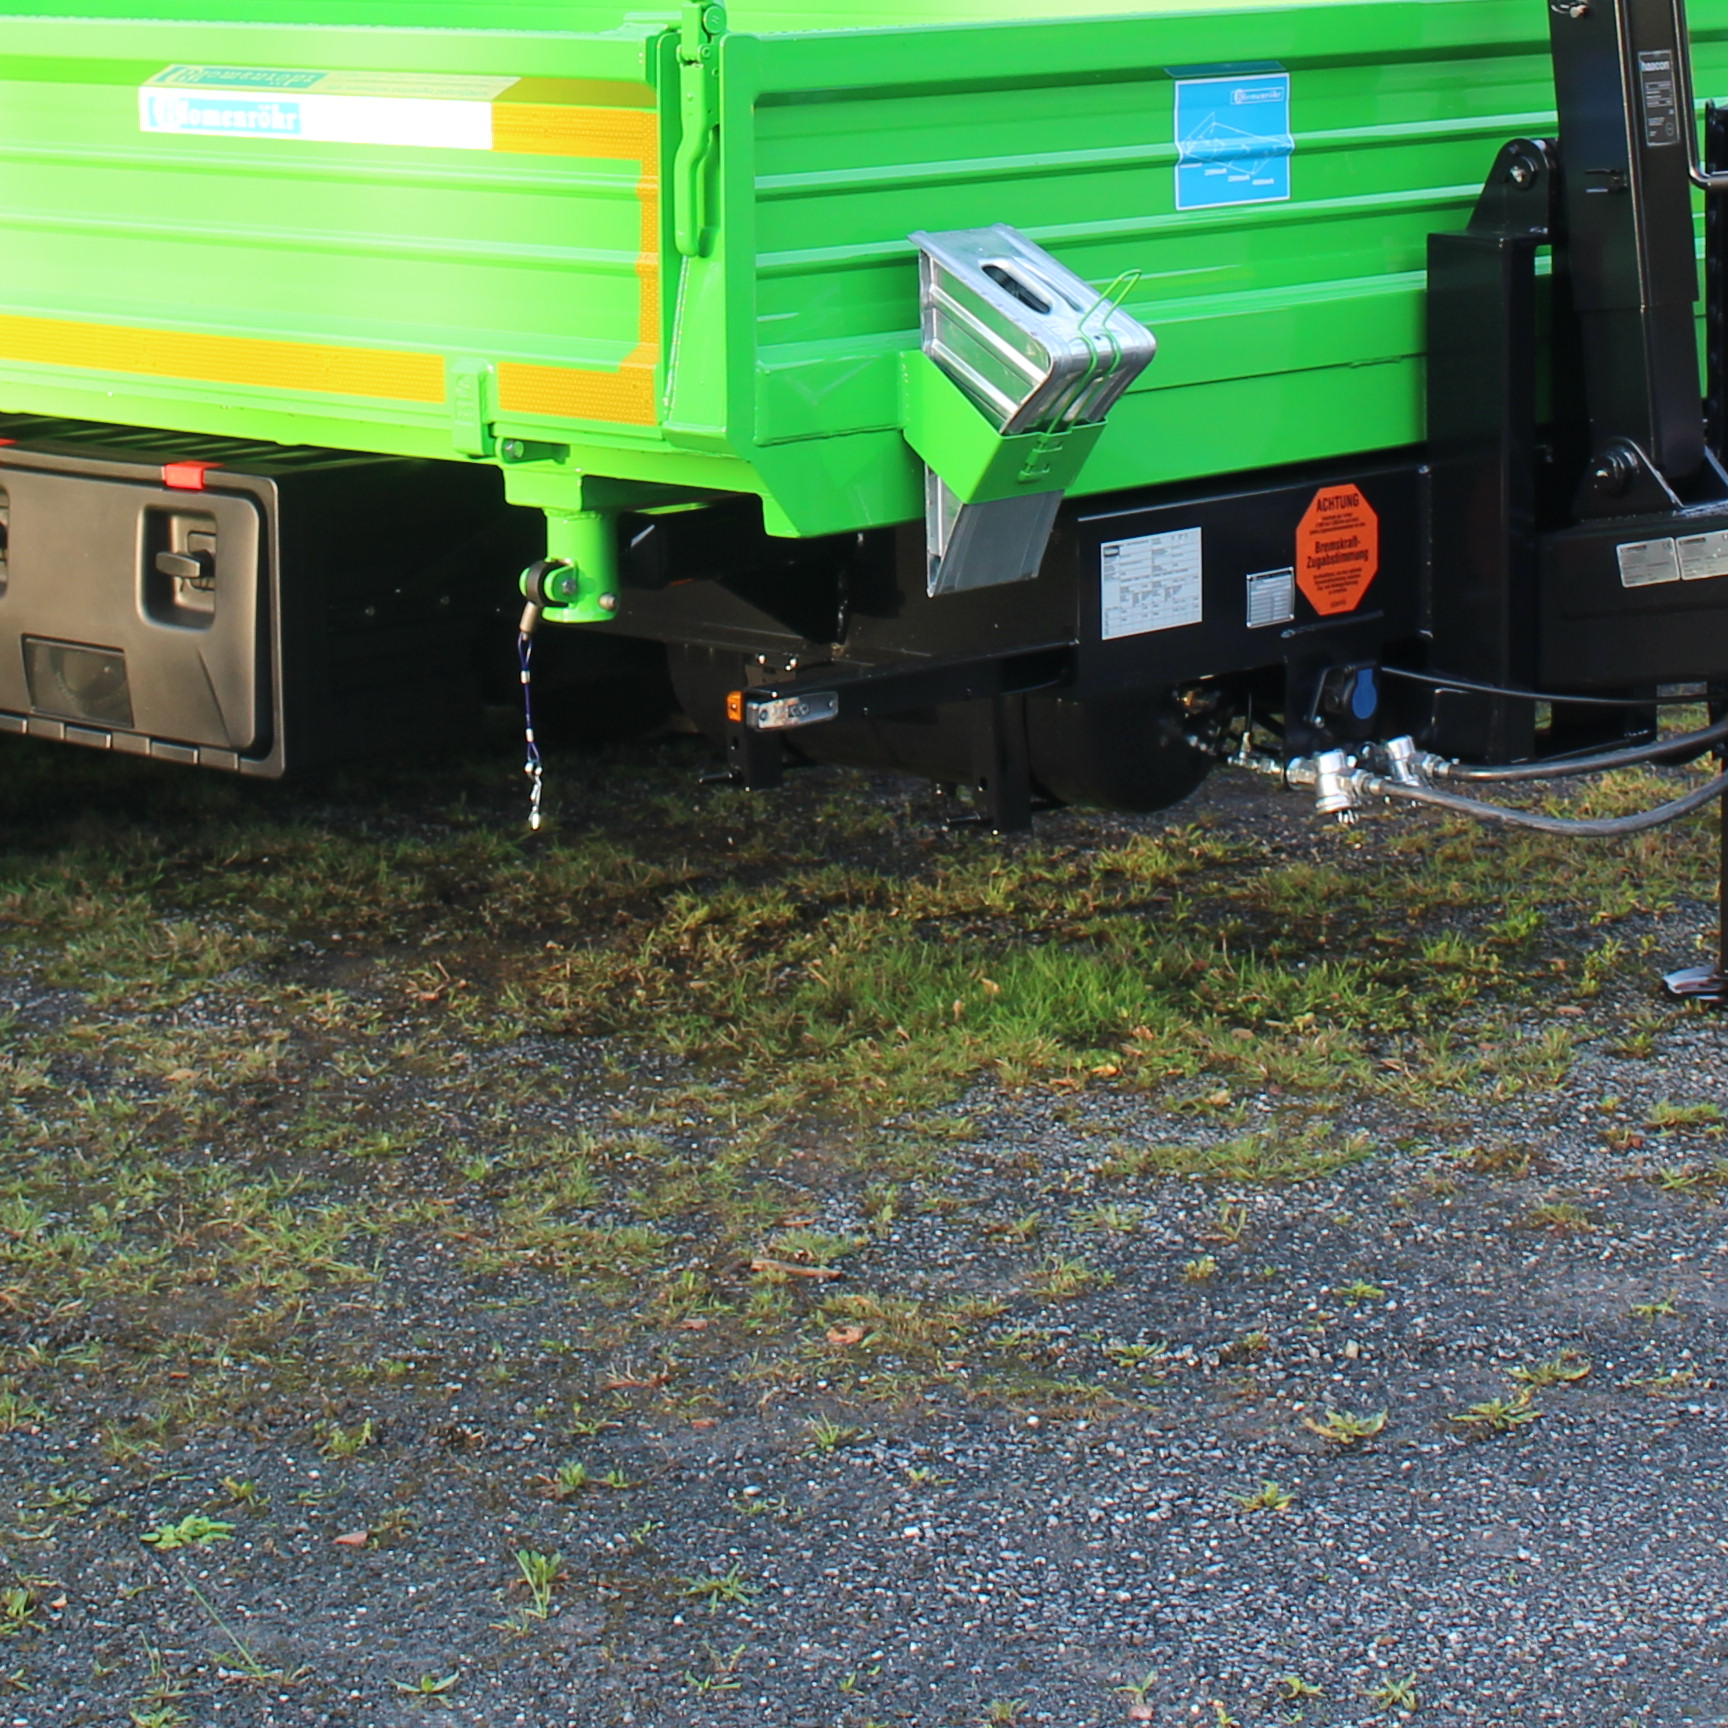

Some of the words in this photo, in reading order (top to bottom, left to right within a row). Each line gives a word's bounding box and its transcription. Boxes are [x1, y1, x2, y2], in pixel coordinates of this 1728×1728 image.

[1316, 493, 1359, 512] ACHTUNG
[1315, 535, 1361, 554] Bremskraft-
[1306, 548, 1369, 570] Zugabstimmung
